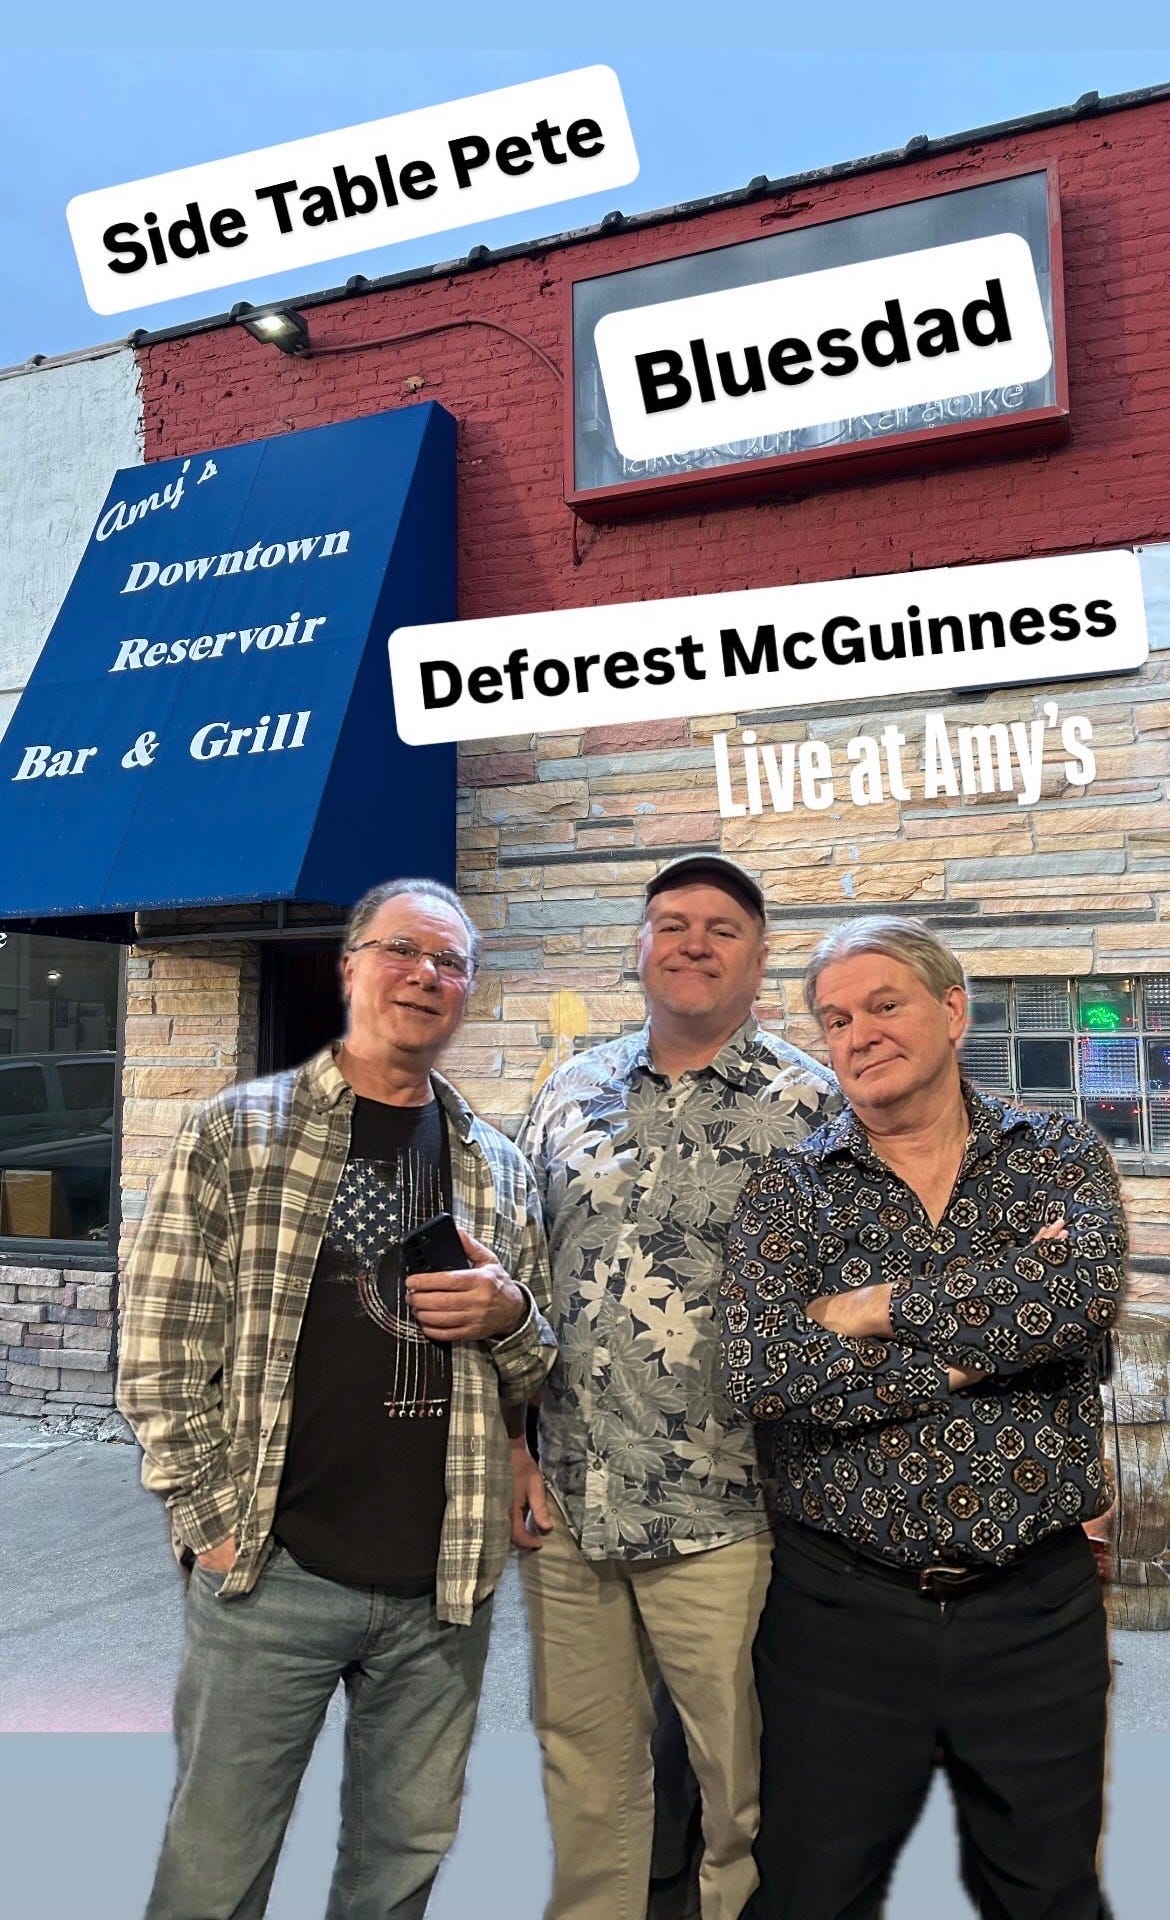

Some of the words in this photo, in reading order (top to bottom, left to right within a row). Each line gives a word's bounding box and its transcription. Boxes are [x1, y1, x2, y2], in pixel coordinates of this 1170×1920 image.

[119, 530, 350, 594] Downtown
[108, 611, 327, 673] Reservoir
[11, 745, 98, 781] Bar
[121, 730, 160, 769] &
[189, 710, 312, 760] Grill
